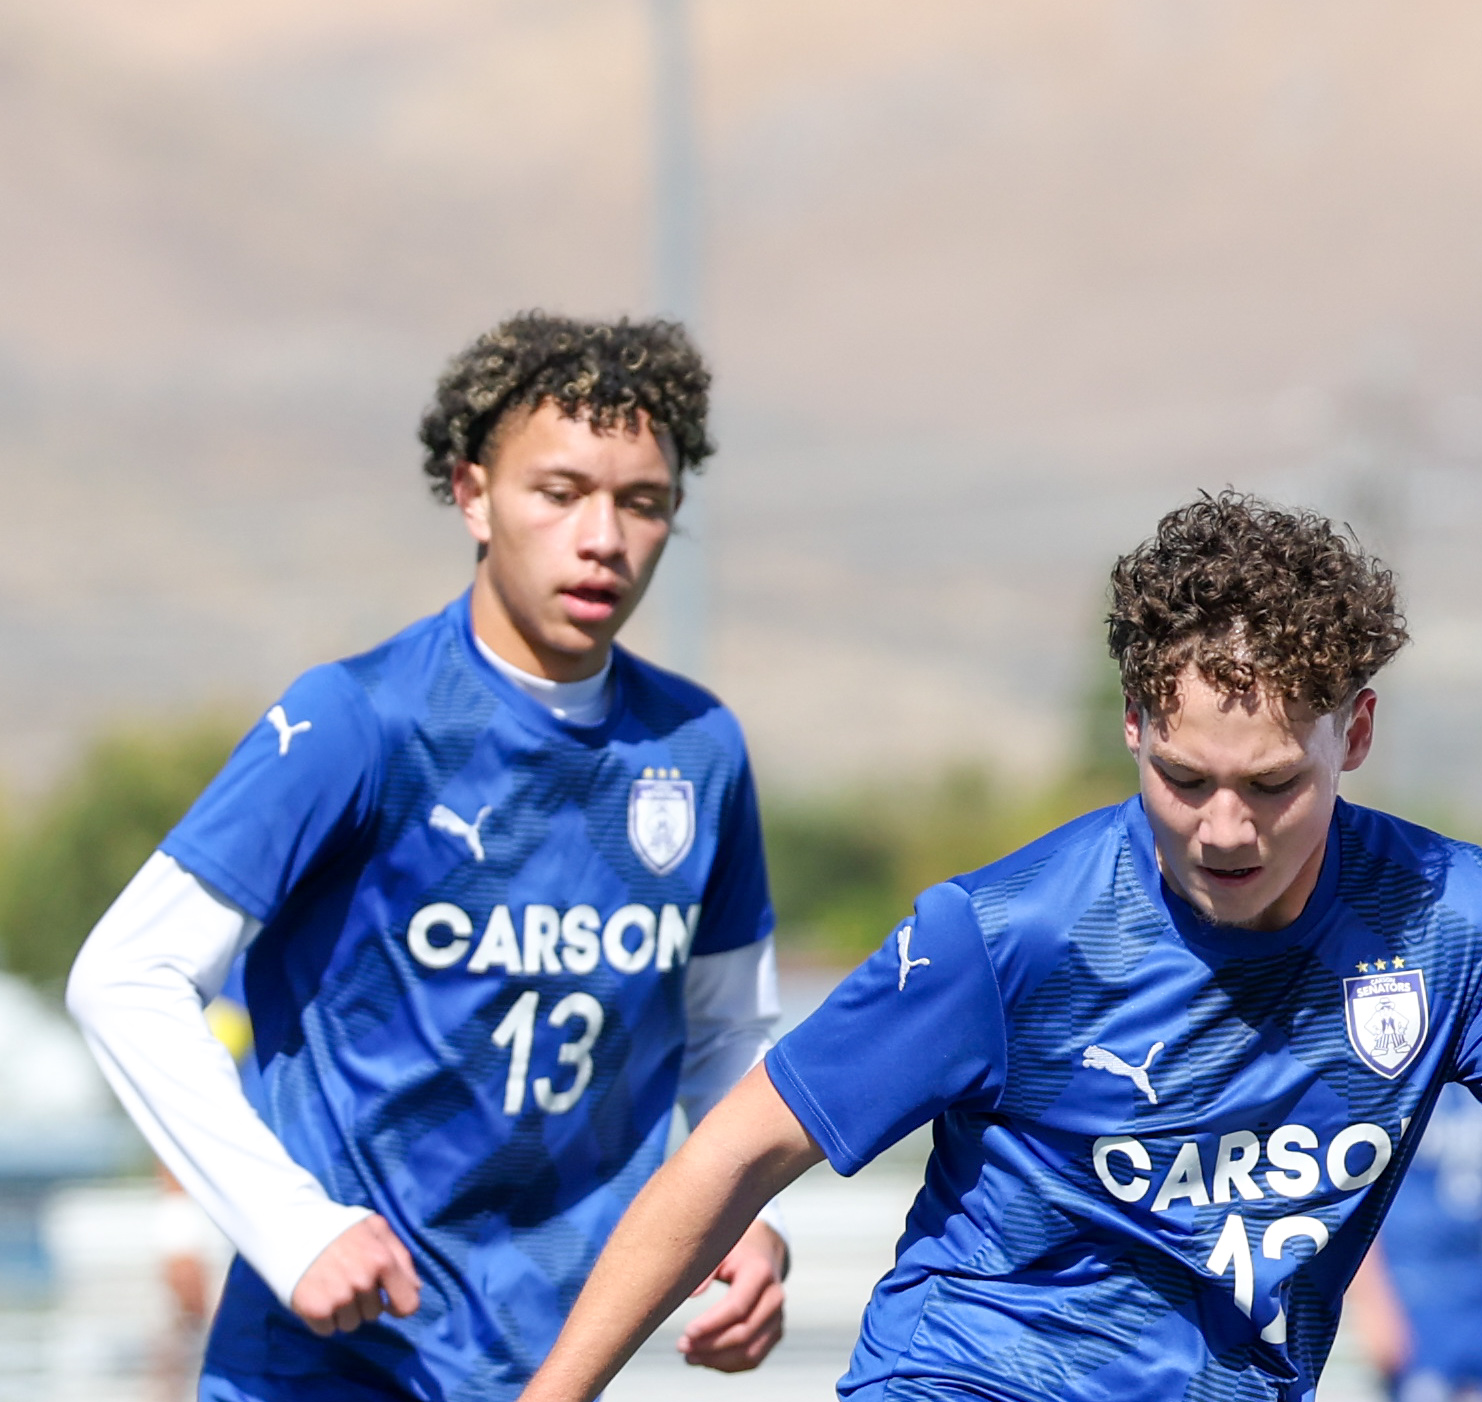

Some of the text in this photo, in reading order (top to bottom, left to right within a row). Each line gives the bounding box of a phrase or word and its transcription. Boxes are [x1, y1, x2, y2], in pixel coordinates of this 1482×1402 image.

[407, 902, 701, 976] CARSON
[1356, 982, 1412, 998] SENATORS
[491, 991, 604, 1116] 13
[1092, 1116, 1412, 1212] CARSO
